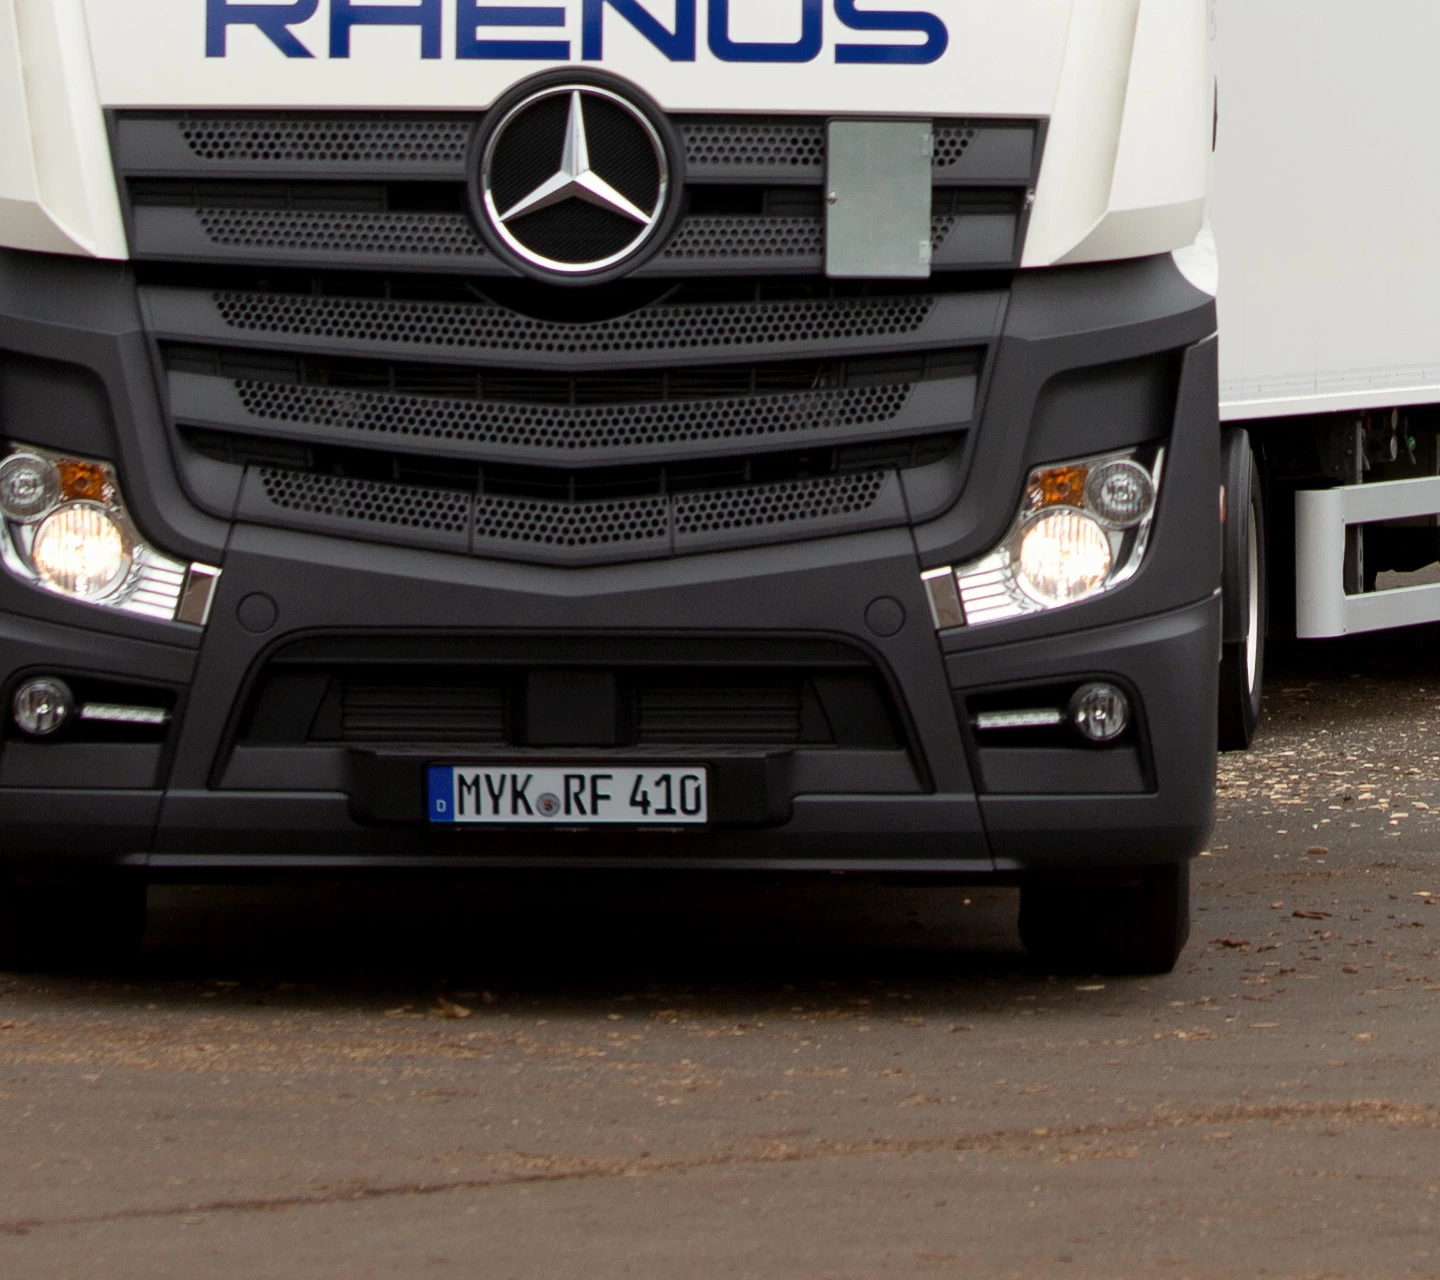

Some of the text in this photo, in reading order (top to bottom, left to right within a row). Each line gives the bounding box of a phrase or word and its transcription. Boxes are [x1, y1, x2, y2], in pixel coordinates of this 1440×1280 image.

[436, 773, 703, 816] D MYK RF 410
